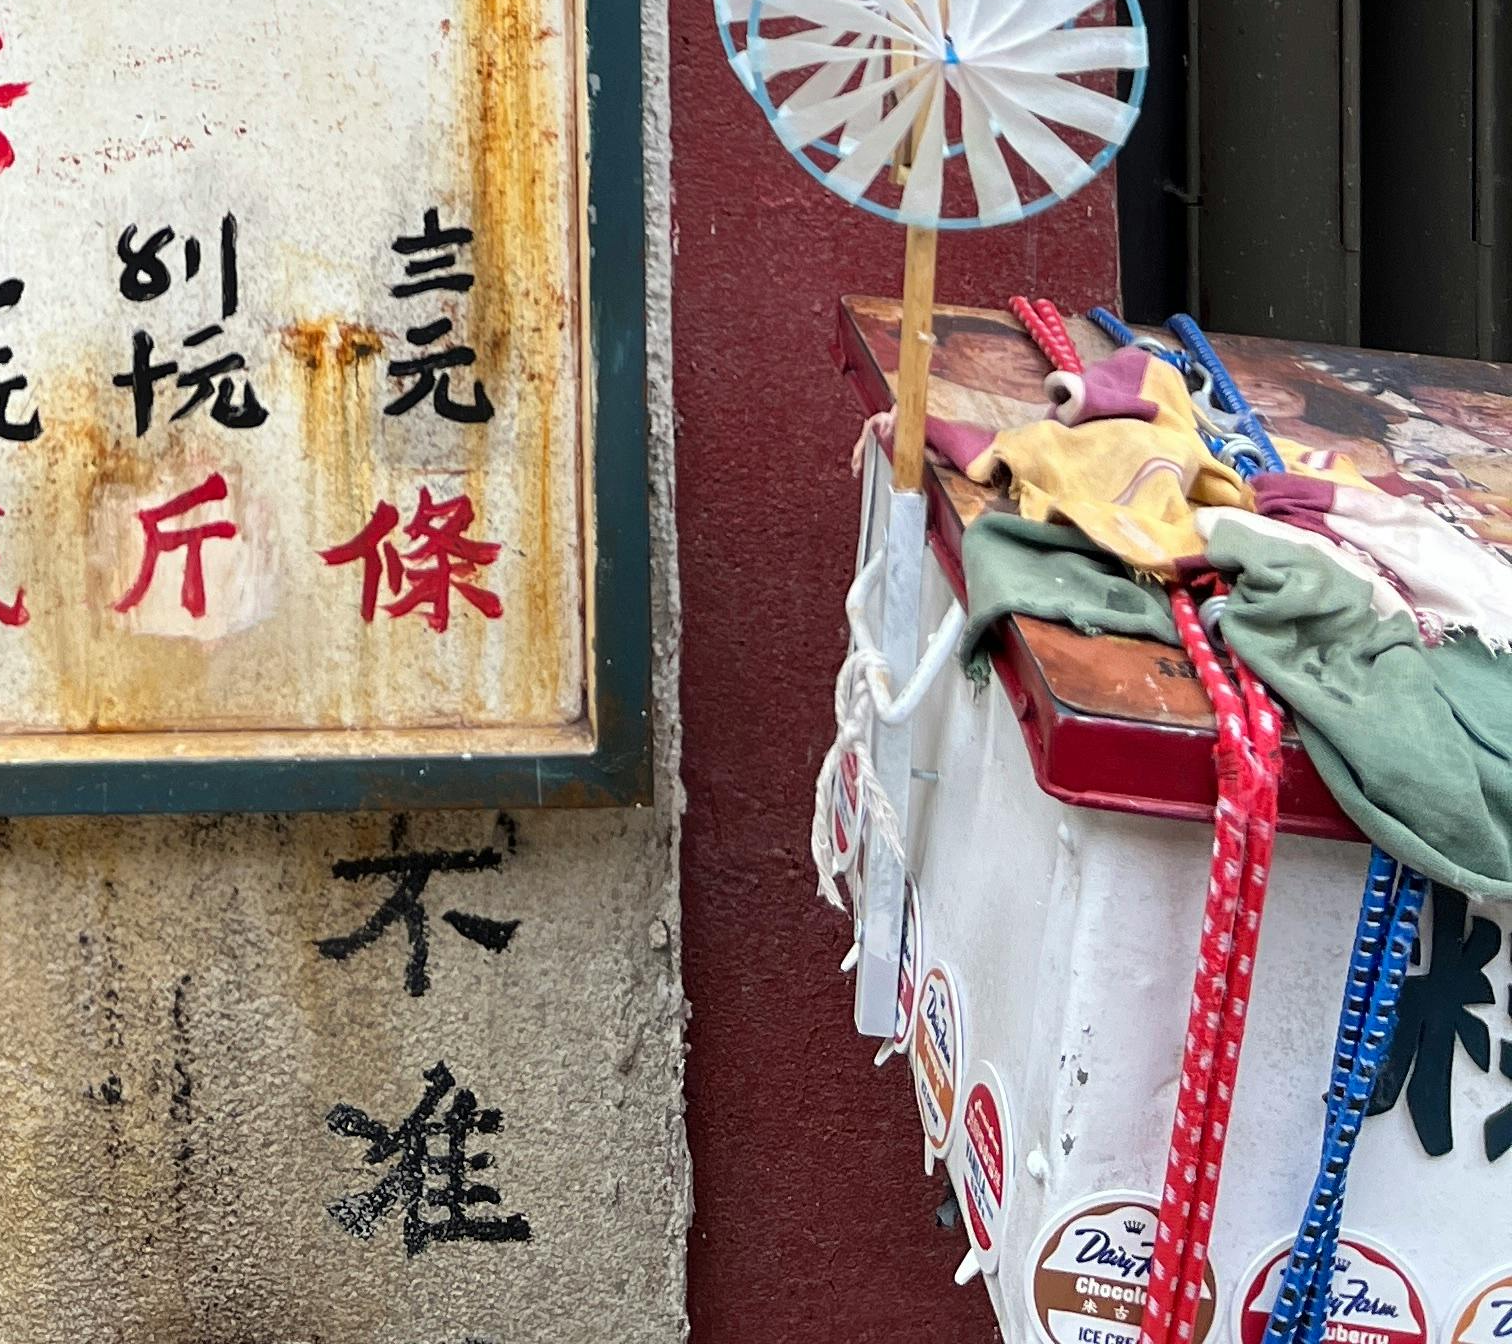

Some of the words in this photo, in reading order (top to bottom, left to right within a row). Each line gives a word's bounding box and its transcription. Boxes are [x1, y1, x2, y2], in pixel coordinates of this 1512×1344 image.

[1074, 1228, 1137, 1278] Dairy
[1074, 1276, 1147, 1305] Chocol
[1339, 1279, 1399, 1318] Farm
